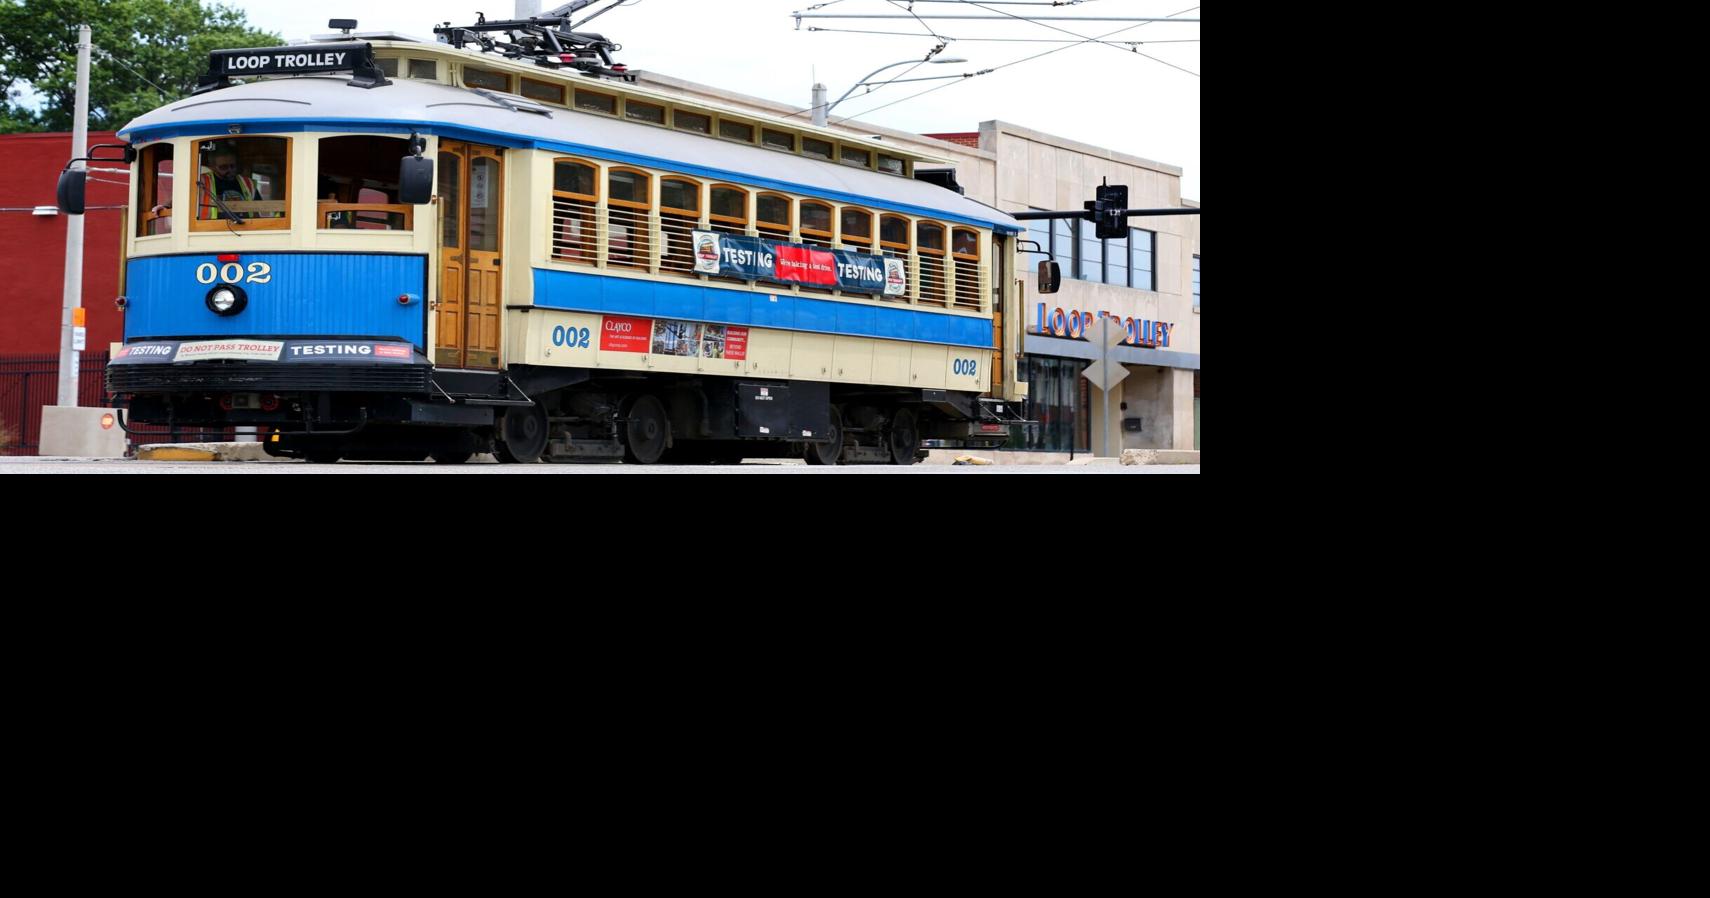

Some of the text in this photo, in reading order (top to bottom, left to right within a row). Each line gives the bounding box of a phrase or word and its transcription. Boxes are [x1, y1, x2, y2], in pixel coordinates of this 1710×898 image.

[227, 52, 346, 70] LOOP TROLLEY
[722, 247, 773, 268] TESTING
[195, 261, 272, 285] 002
[837, 262, 883, 283] TESTING
[1037, 302, 1174, 348] LOOP OLLEY
[552, 324, 590, 349] 002
[129, 345, 172, 356] TESTING
[180, 346, 194, 354] DO
[238, 344, 280, 353] TROLLEY
[290, 345, 372, 356] TESTING
[953, 358, 977, 376] 002
